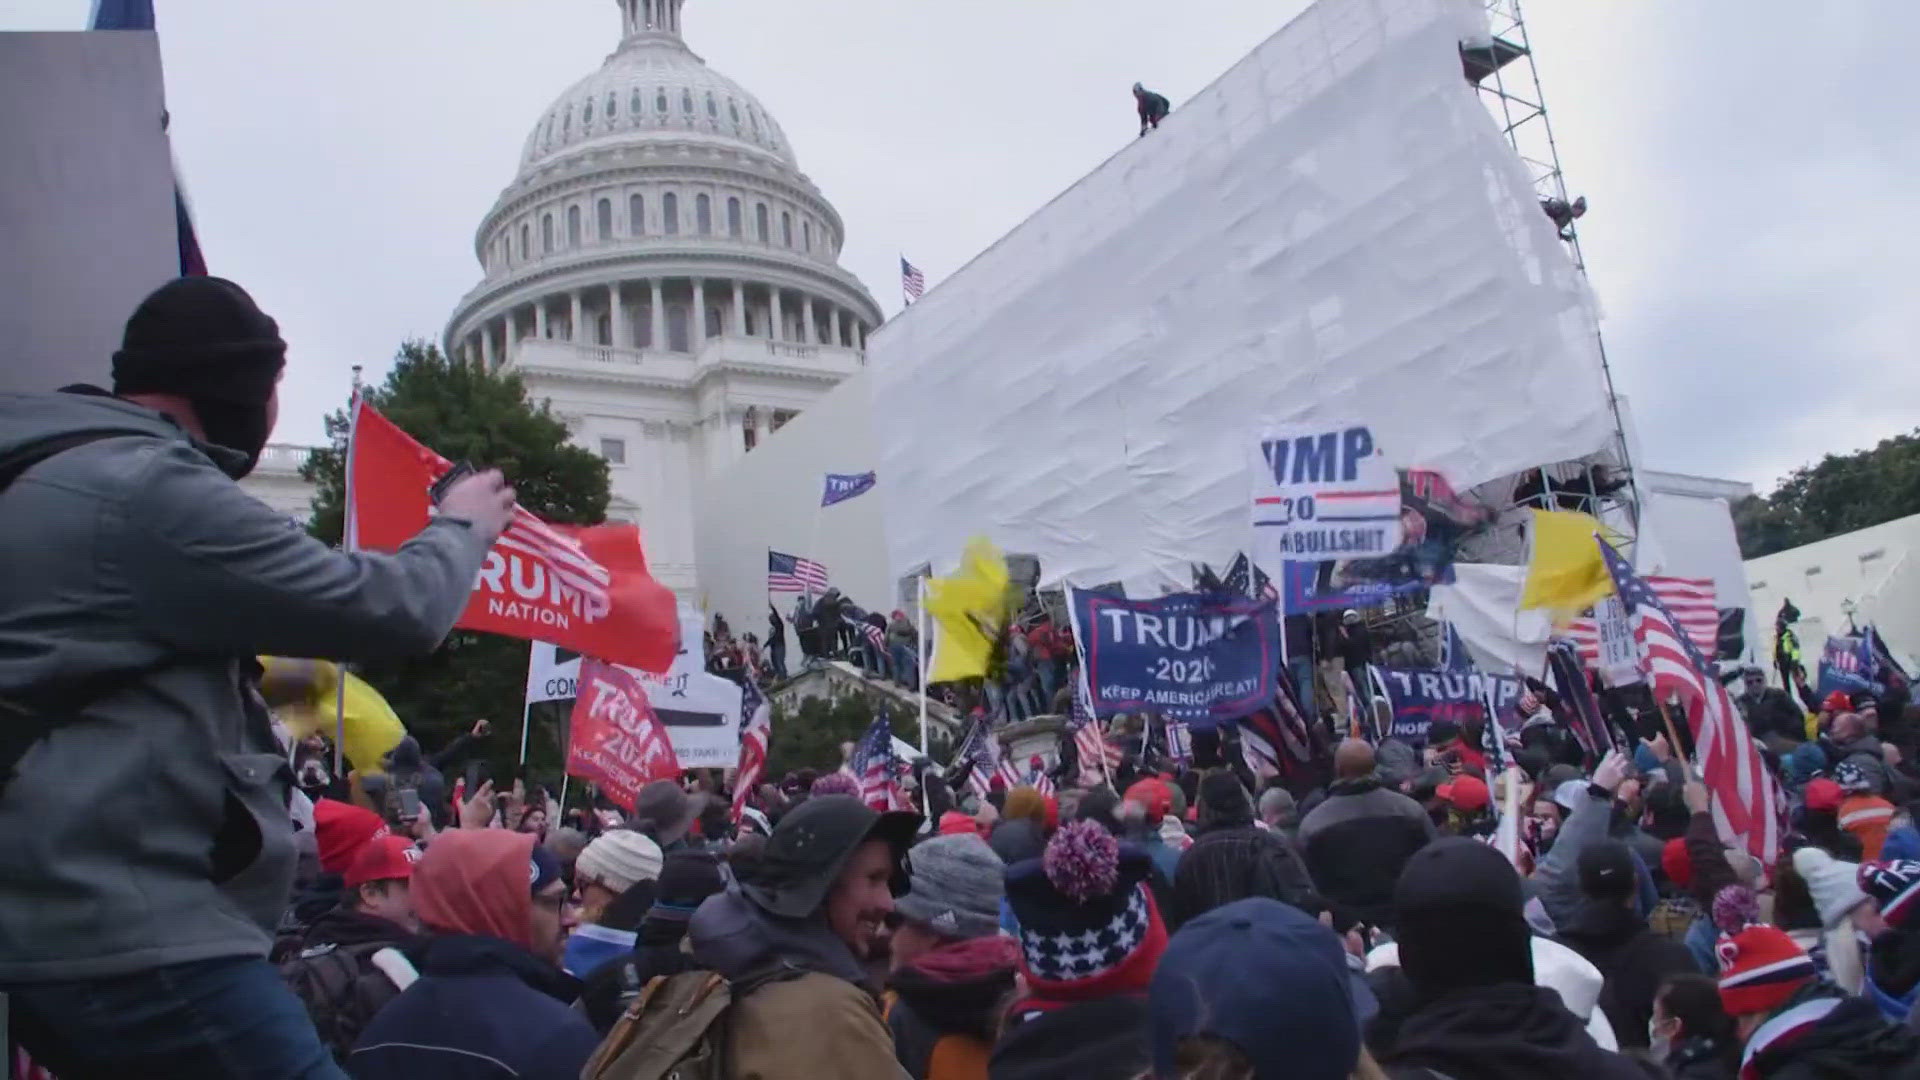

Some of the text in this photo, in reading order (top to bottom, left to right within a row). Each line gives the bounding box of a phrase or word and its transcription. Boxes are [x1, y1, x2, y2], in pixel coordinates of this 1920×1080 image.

[1261, 427, 1373, 486] UMP
[472, 551, 612, 624] RUMP
[488, 598, 569, 630] NATION
[1101, 608, 1250, 651] TRUM
[1102, 683, 1141, 700] KEEP
[1391, 670, 1520, 706] TRUMP
